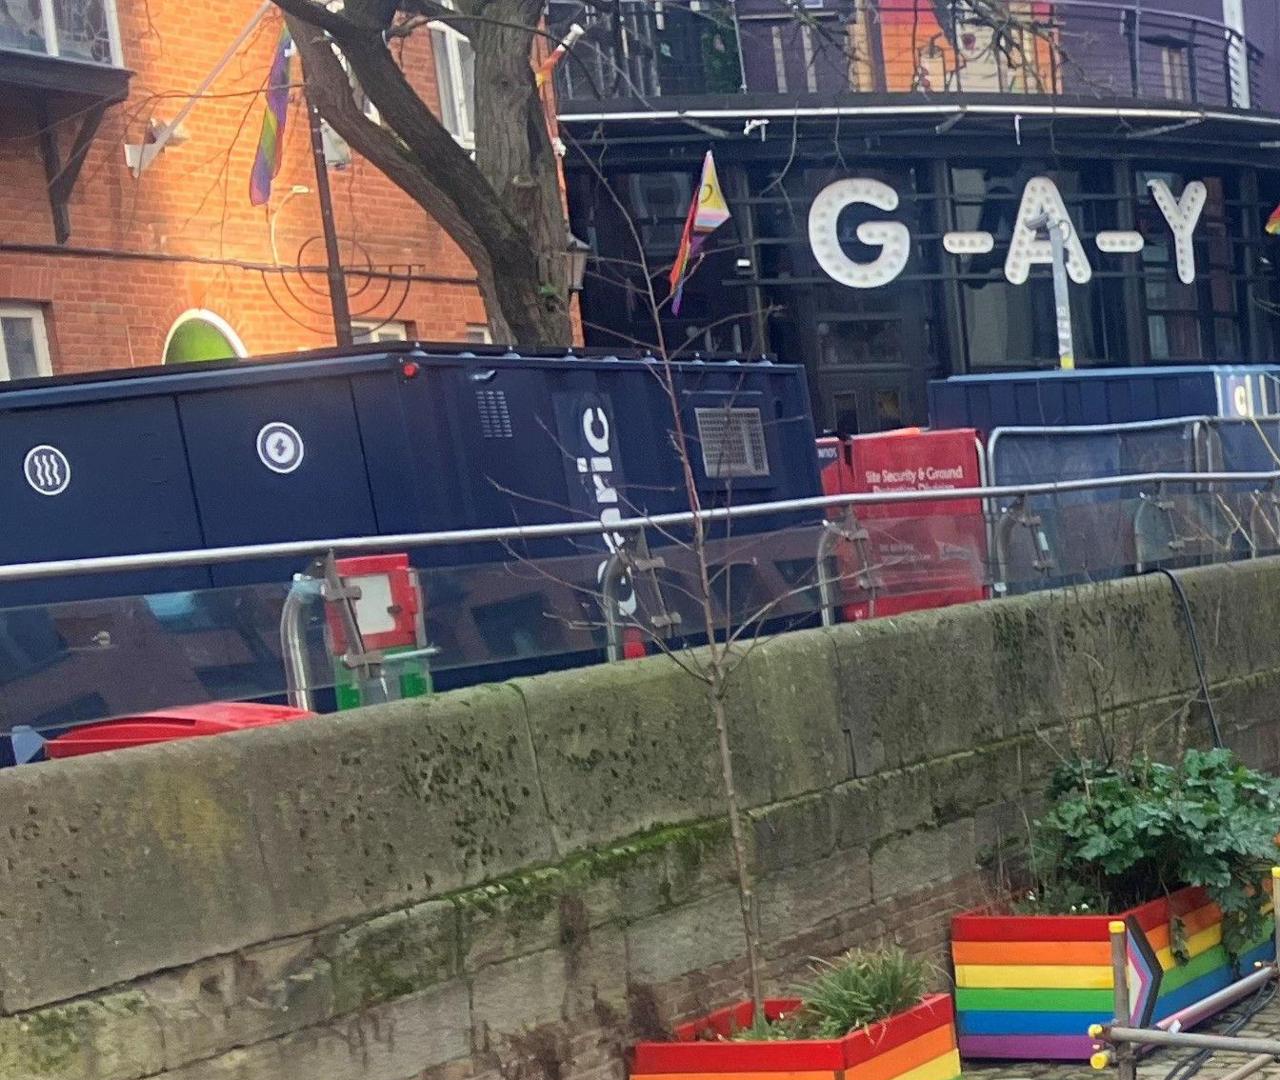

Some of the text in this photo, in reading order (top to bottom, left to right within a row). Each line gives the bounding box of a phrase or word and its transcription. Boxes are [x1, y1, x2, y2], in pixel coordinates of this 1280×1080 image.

[808, 176, 1207, 288] G-A-Y
[865, 471, 881, 484] Site
[883, 468, 917, 485] Security
[926, 466, 964, 481] Ground
